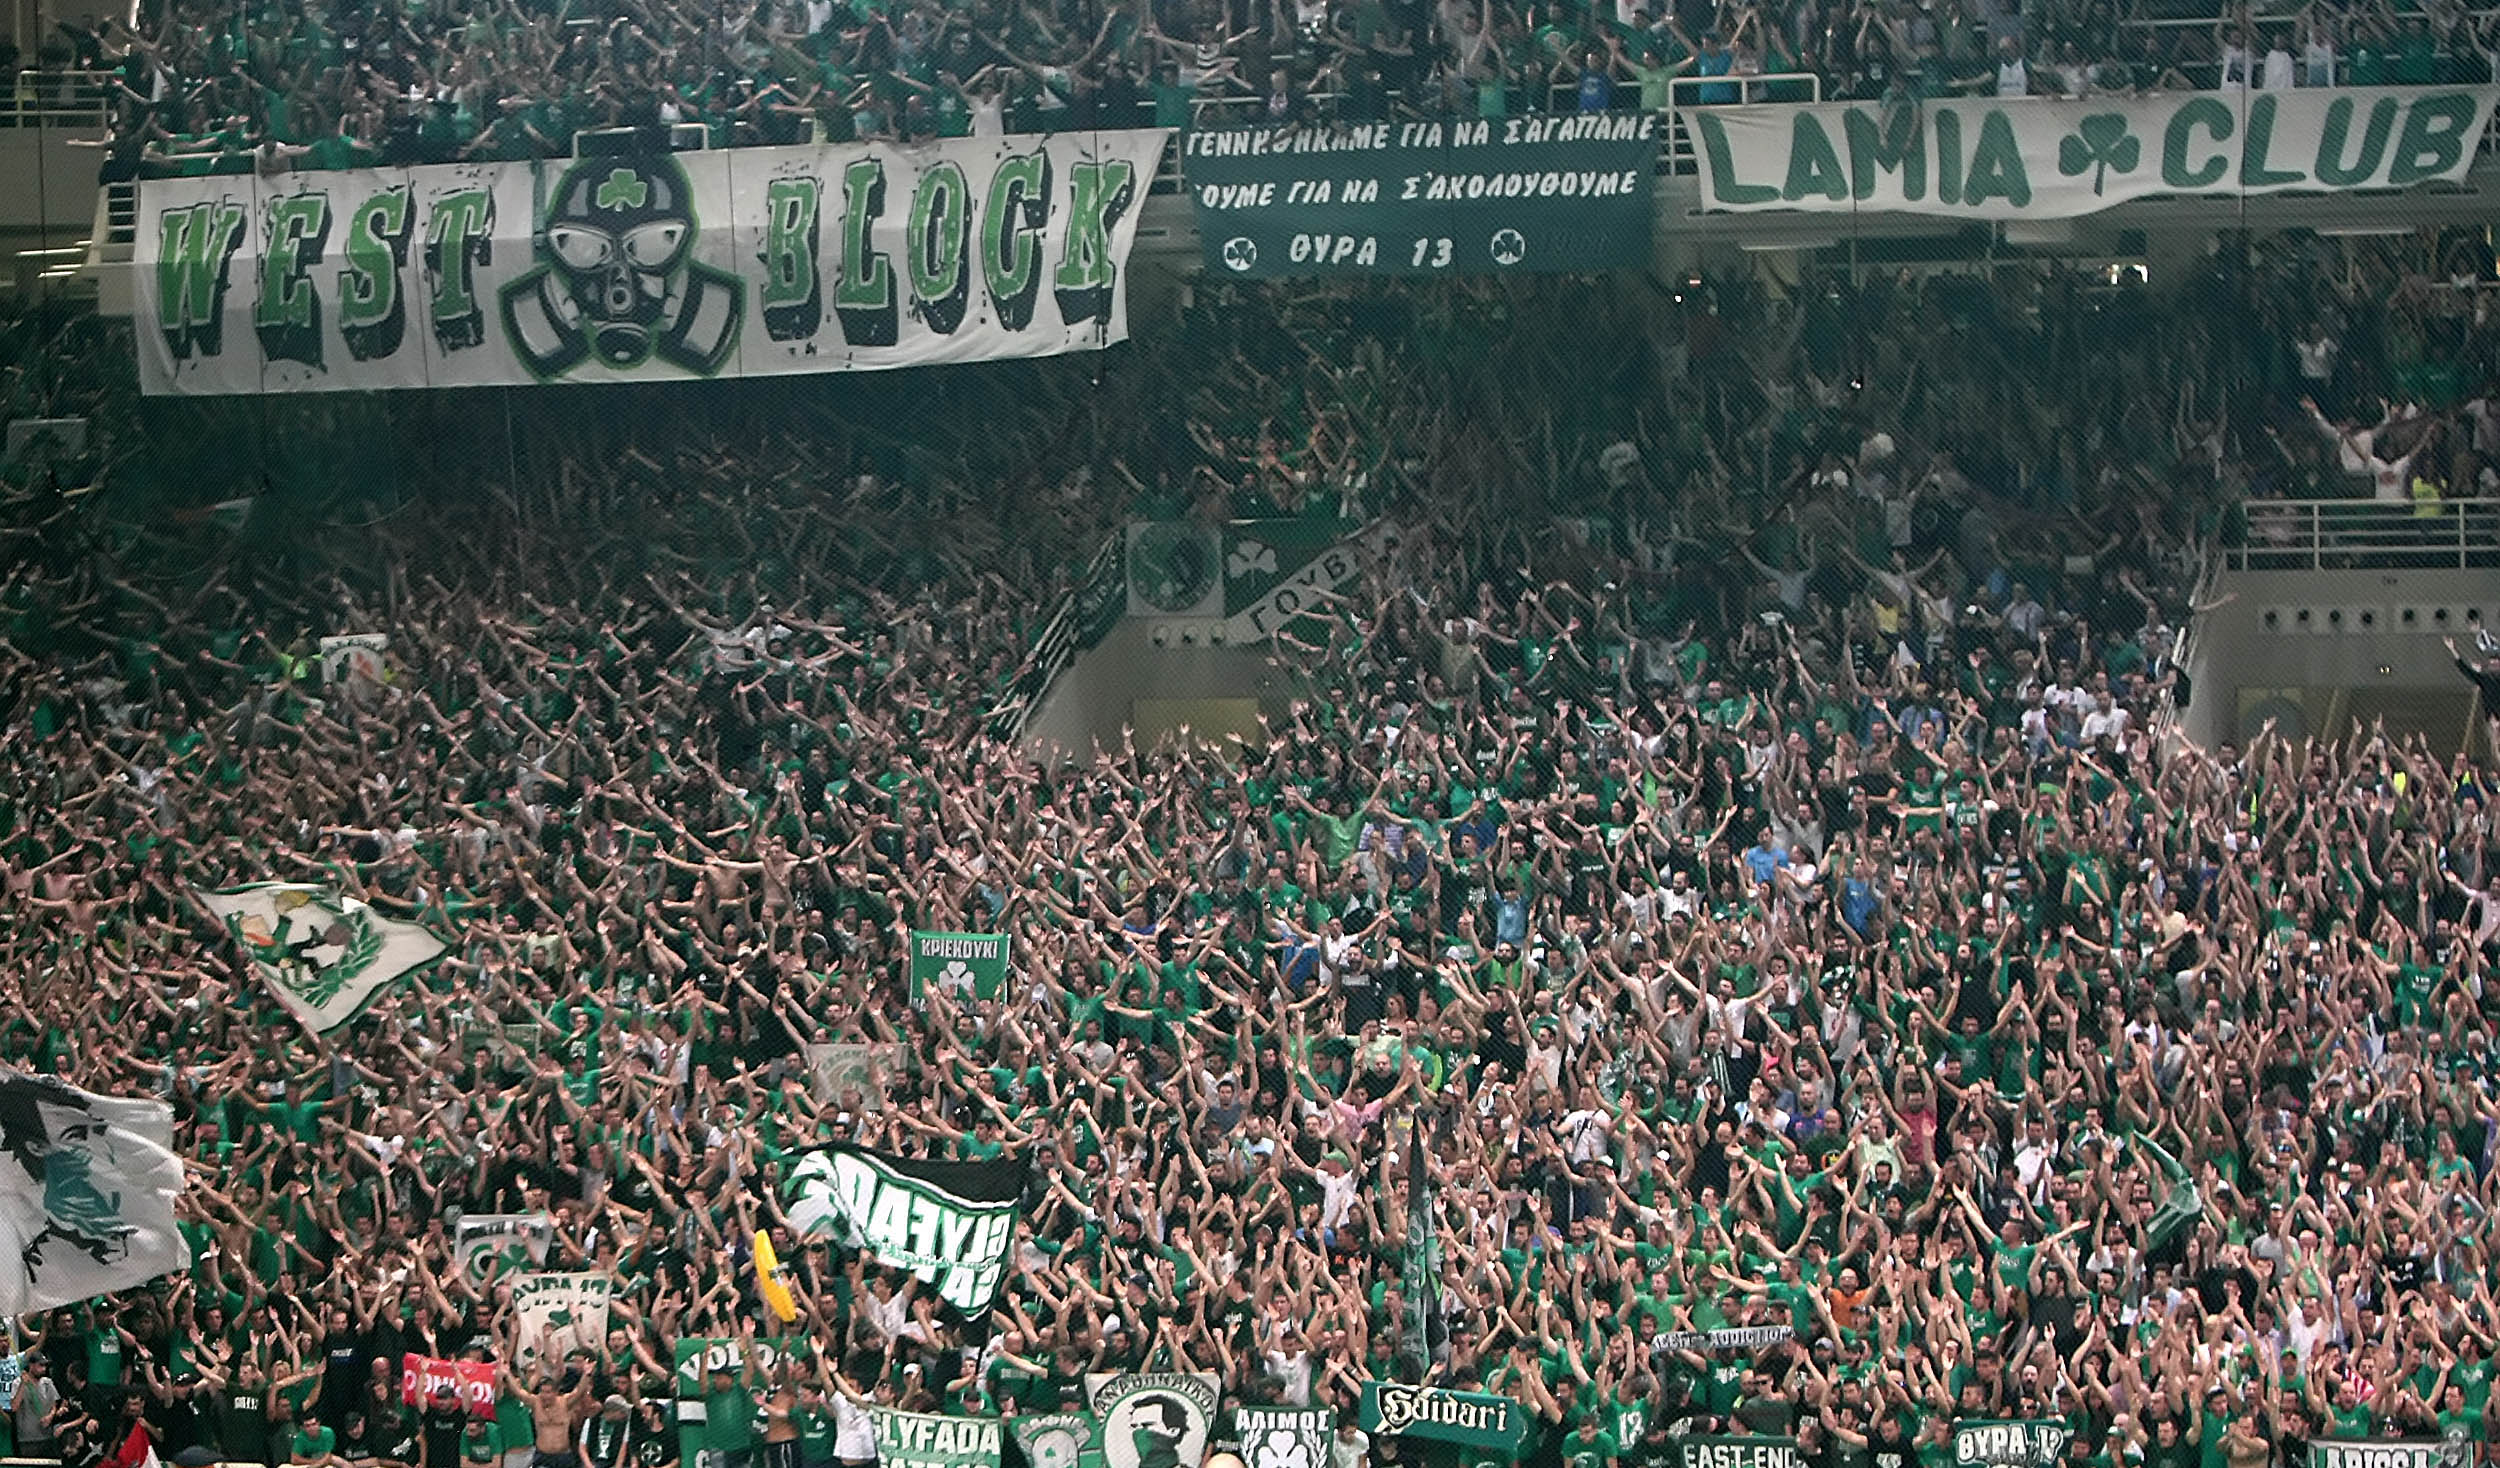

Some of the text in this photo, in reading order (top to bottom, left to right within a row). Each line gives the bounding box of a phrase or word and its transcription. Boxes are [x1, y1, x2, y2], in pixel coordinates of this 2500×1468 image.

[1400, 121, 1442, 148] ΓΙΑ
[1454, 120, 1491, 147] ΝΑ
[1698, 94, 2478, 206] LAMIA CLUB
[1194, 183, 1277, 210] ΟΥΜΕ
[1287, 180, 1332, 204] ΓΙΑ
[1341, 179, 1380, 203] ΝΑ
[158, 146, 1134, 362] WEST BLOCK
[1289, 233, 1453, 268] ΘΥΡΑ 13
[872, 1408, 1001, 1456] GLYFADA
[1236, 1408, 1330, 1431] ΑΛΙΜΟΣ
